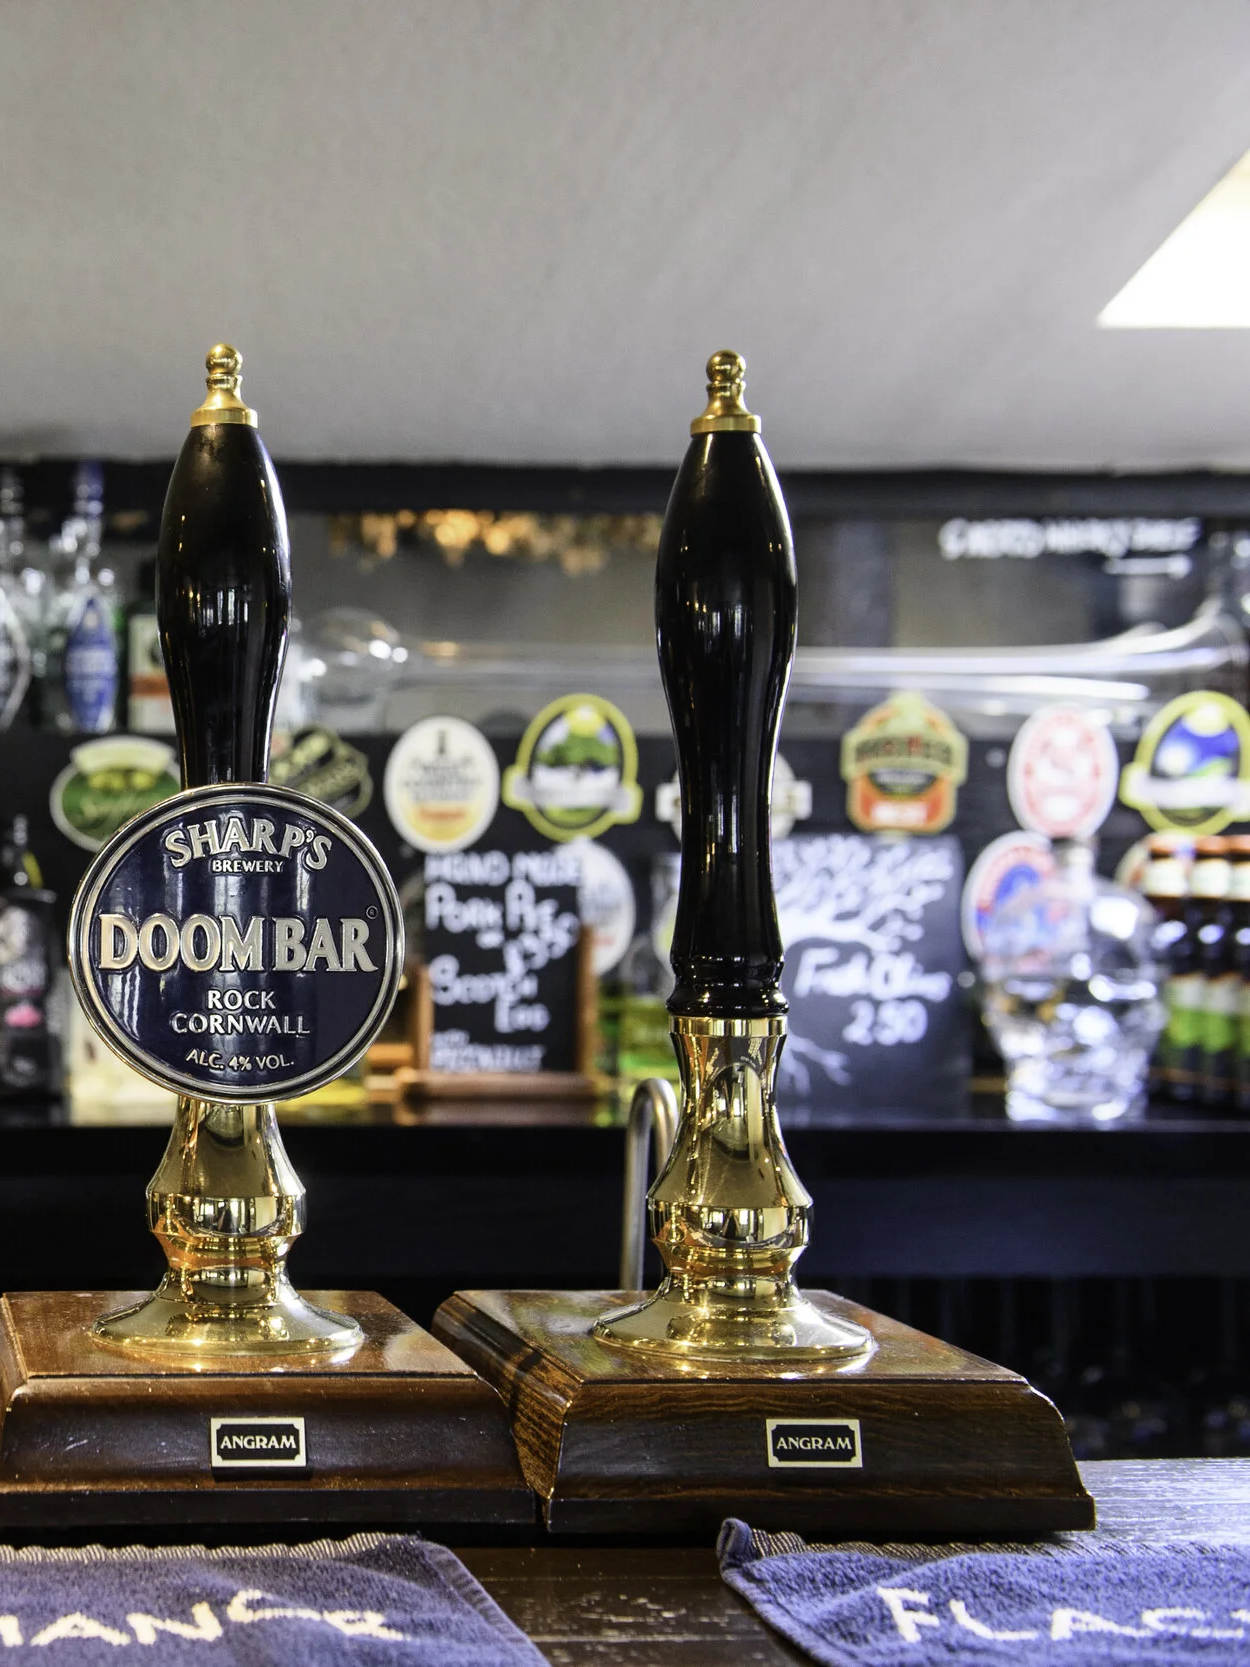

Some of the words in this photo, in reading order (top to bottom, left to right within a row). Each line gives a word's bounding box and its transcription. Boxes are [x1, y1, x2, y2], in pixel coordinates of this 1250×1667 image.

[164, 817, 332, 869] SHARP'S
[212, 859, 285, 873] BREWERY
[99, 913, 265, 972] DOOM
[272, 916, 379, 972] BAR
[207, 989, 276, 1010] ROCK
[171, 1013, 310, 1035] CORNWALL
[185, 1048, 224, 1069] ALC.
[229, 1056, 252, 1071] 4%
[255, 1054, 294, 1070] VOL.
[220, 1435, 297, 1449] ANGRAM
[777, 1437, 852, 1450] ANGRAM
